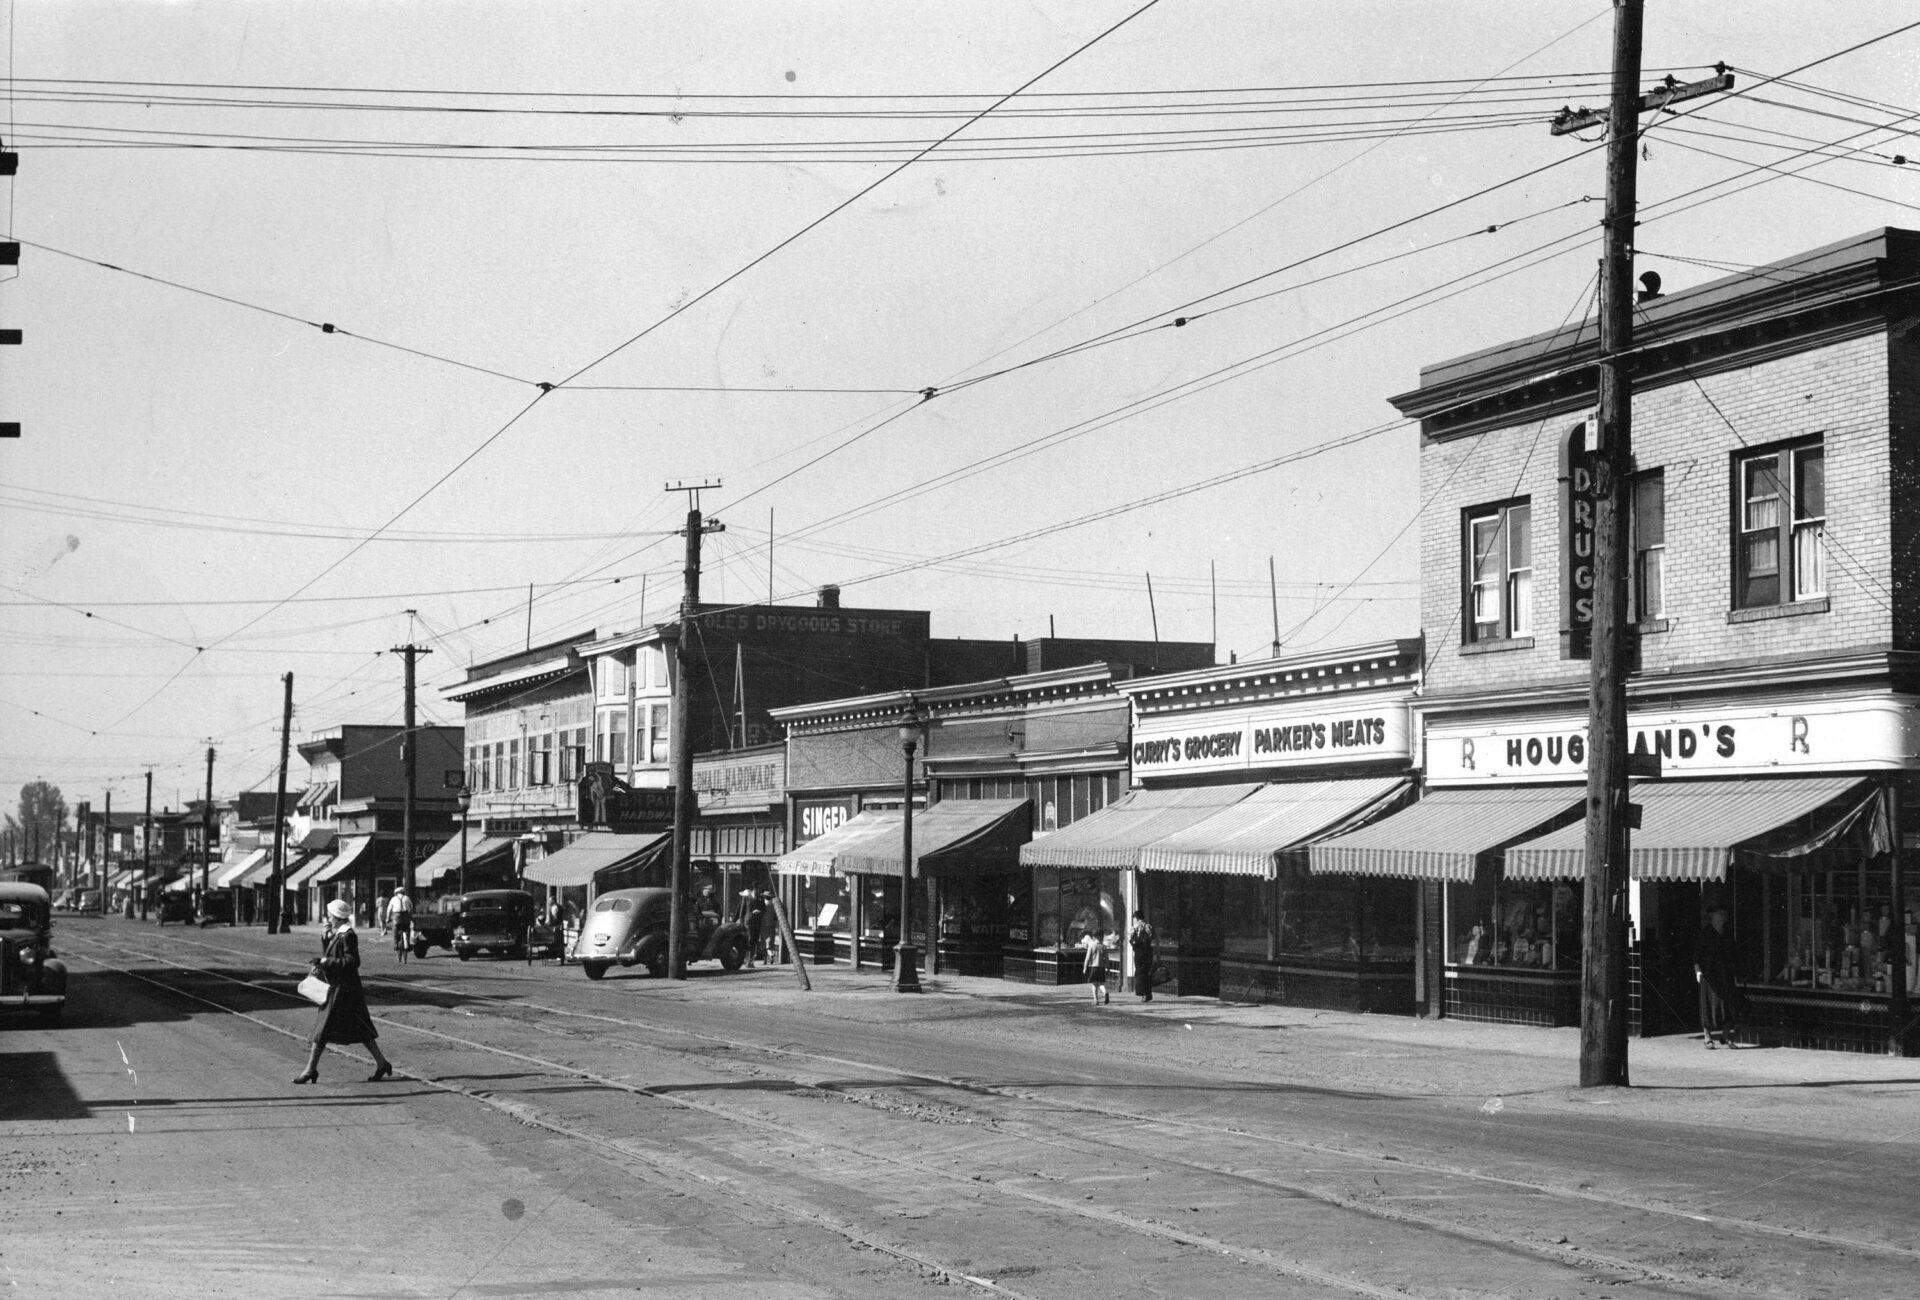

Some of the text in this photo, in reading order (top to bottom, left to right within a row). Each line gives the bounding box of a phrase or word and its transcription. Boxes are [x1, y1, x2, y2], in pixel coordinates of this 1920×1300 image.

[1573, 467, 1594, 622] DRUGS
[757, 615, 840, 633] DRYGOODS
[847, 618, 903, 636] STORE
[1133, 730, 1242, 765] CURRY'S GROCERY
[1254, 717, 1385, 754] PARKER'S MEATS
[1506, 724, 1736, 766] HOUGAND'S
[725, 763, 776, 792] HARDWARE
[618, 809, 674, 821] HARDWA
